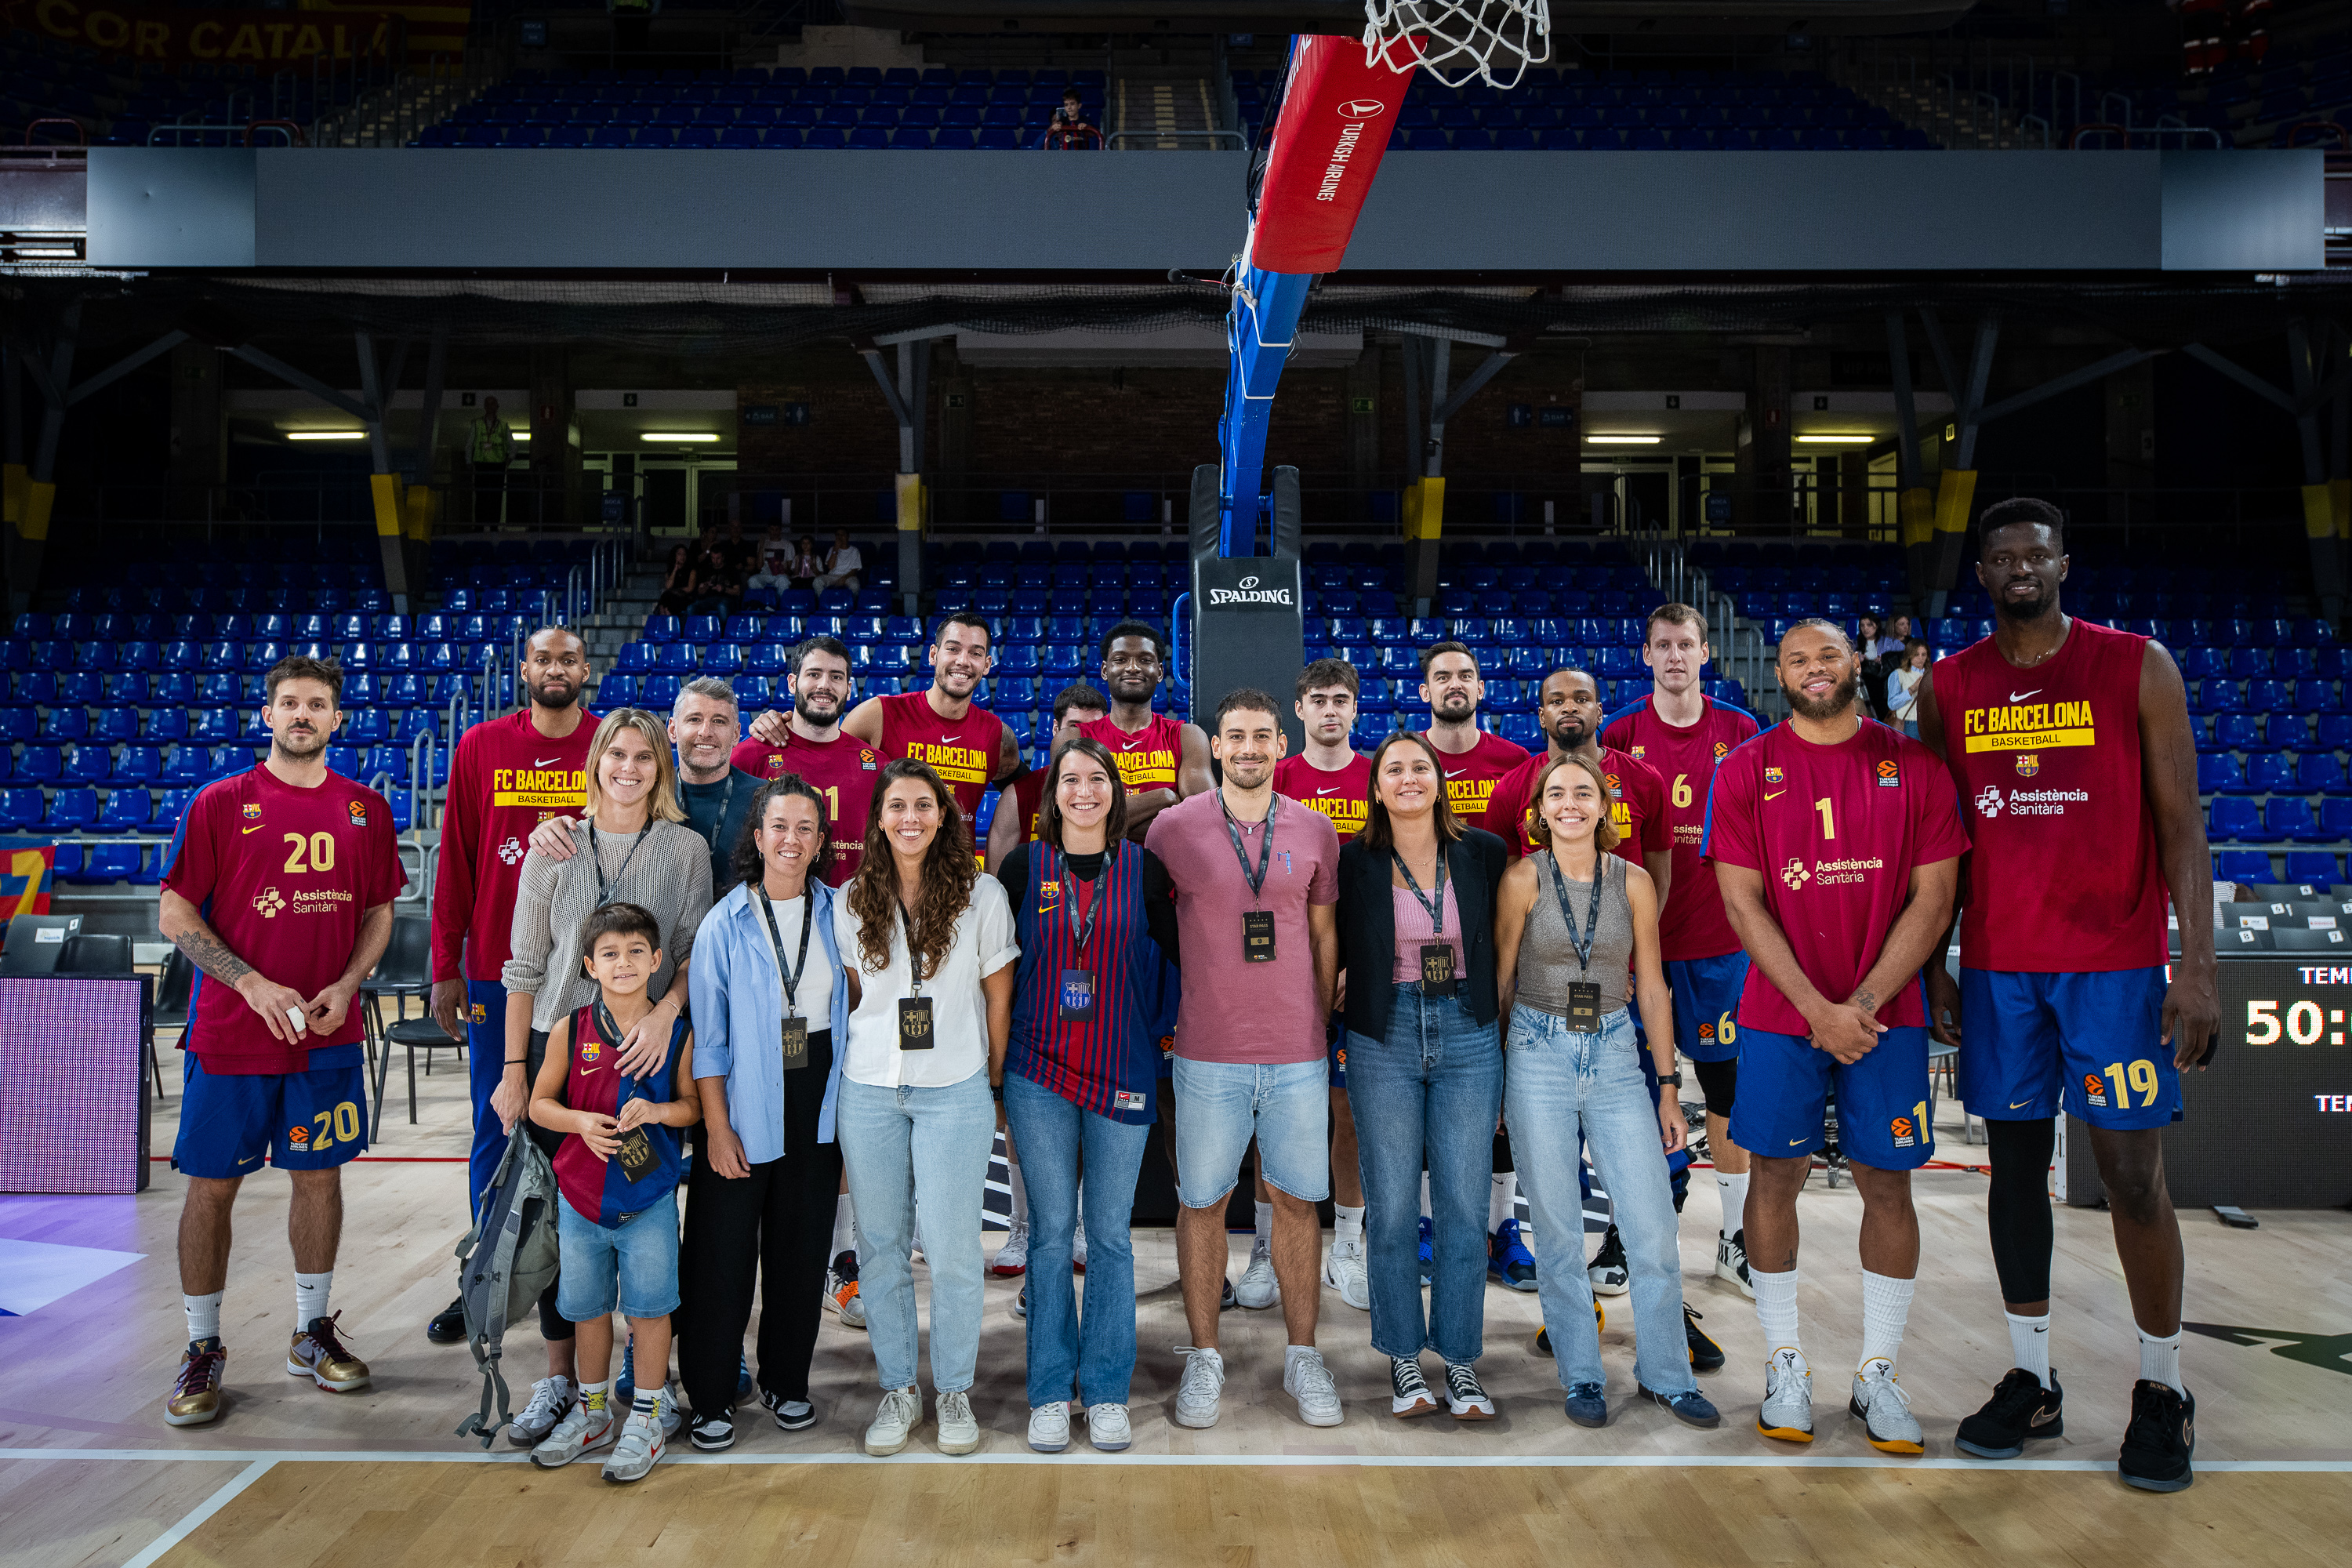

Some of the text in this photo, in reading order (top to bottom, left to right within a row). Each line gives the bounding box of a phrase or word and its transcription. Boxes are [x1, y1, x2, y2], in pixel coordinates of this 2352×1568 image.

[34, 0, 171, 57] COR
[1316, 122, 1364, 201] TURKISH AIRLINES
[1965, 701, 2094, 735] FC BARCELONA
[908, 742, 987, 770] FC BARCELONA
[1992, 734, 2061, 747] BASKETBALL
[494, 769, 512, 790] FC
[1672, 774, 1692, 808] 6
[2009, 789, 2089, 802] Assistència
[1815, 797, 1835, 840] 1
[2010, 802, 2064, 815] Sanitària
[284, 831, 334, 873] 20
[1815, 857, 1883, 872] Assistència
[1817, 871, 1864, 885] Sanitària
[292, 889, 352, 902] Assistència
[293, 901, 337, 913] Sanitària
[2298, 967, 2352, 984] TEM
[1718, 1011, 1736, 1045] 6
[2246, 1000, 2352, 1045] 50:
[2104, 1059, 2158, 1109] 19
[312, 1101, 360, 1151] 20
[1913, 1100, 1930, 1144] 1
